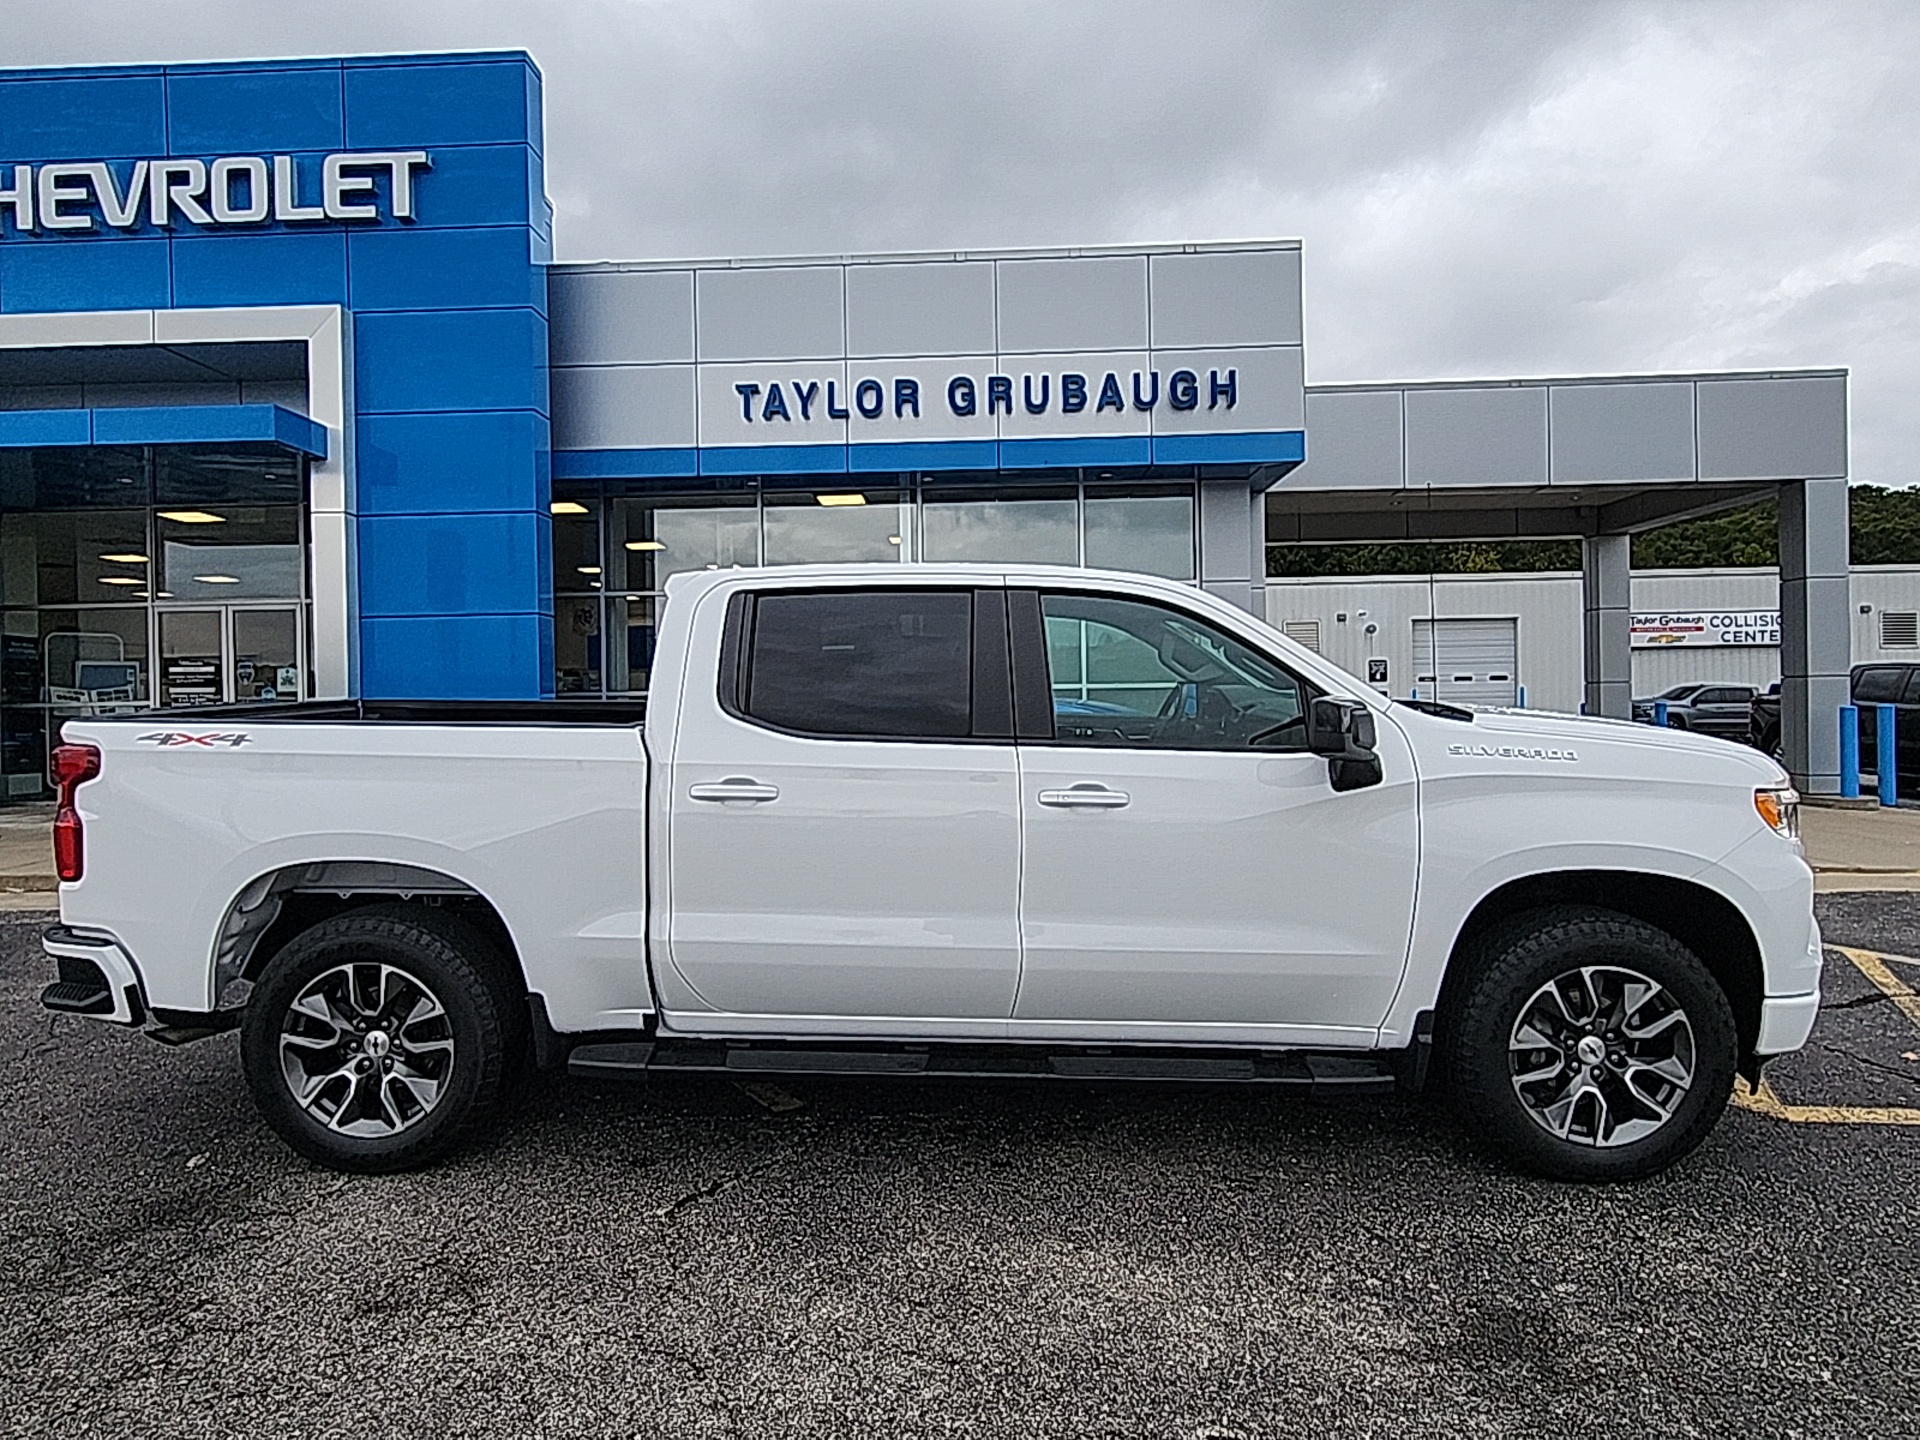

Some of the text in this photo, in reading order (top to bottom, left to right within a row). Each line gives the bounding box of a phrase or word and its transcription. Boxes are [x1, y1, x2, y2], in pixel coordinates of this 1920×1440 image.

[735, 369, 1239, 422] TAYLOR GRUBAUGH
[1629, 615, 1704, 626] Taylor Grubaugh
[1448, 745, 1579, 761] SILVERADO
